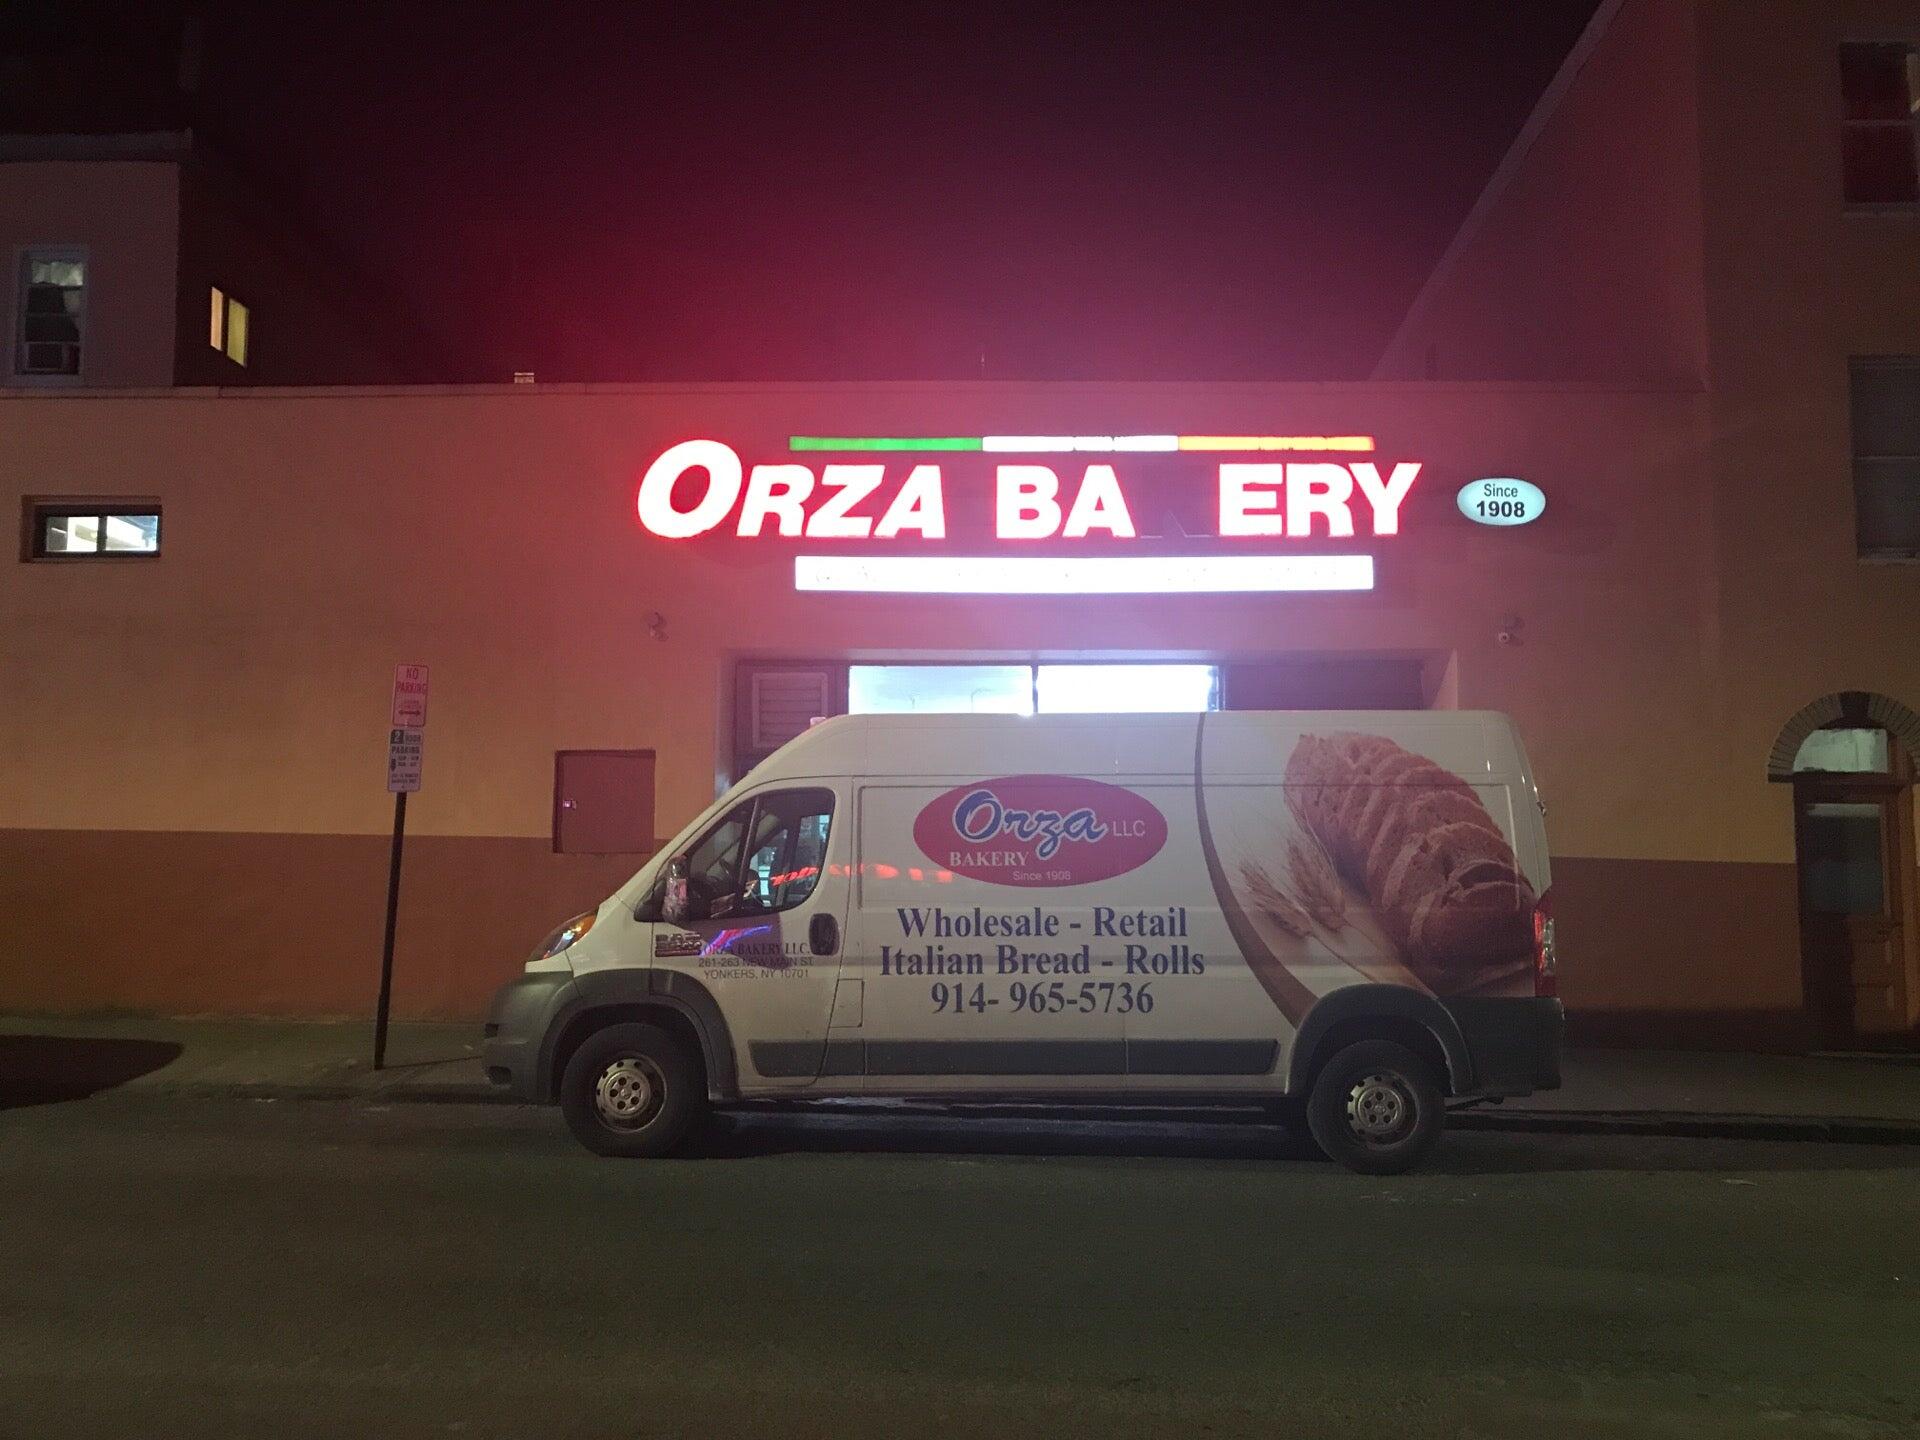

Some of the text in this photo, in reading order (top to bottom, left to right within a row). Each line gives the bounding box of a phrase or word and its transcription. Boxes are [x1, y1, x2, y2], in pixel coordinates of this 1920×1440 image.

[636, 438, 1423, 540] ORZA BAERY
[1483, 483, 1519, 497] Since
[1476, 500, 1526, 518] 1908
[406, 667, 419, 680] NO
[396, 680, 429, 695] PARKING
[394, 731, 402, 743] 2
[952, 789, 1146, 861] Orza LLC
[950, 851, 1030, 867] BAKERY
[1012, 870, 1071, 881] Since 1908
[897, 907, 1060, 938] Wholesale
[1092, 906, 1188, 938] Retail
[737, 943, 780, 955] BAKERY
[699, 957, 740, 968] 261-263
[879, 945, 984, 976] Italian
[995, 944, 1091, 975] Bread
[1125, 944, 1206, 975] Rolls
[761, 969, 776, 978] NY
[780, 968, 809, 979] 10701
[931, 981, 1154, 1014] 914- 965-5736
